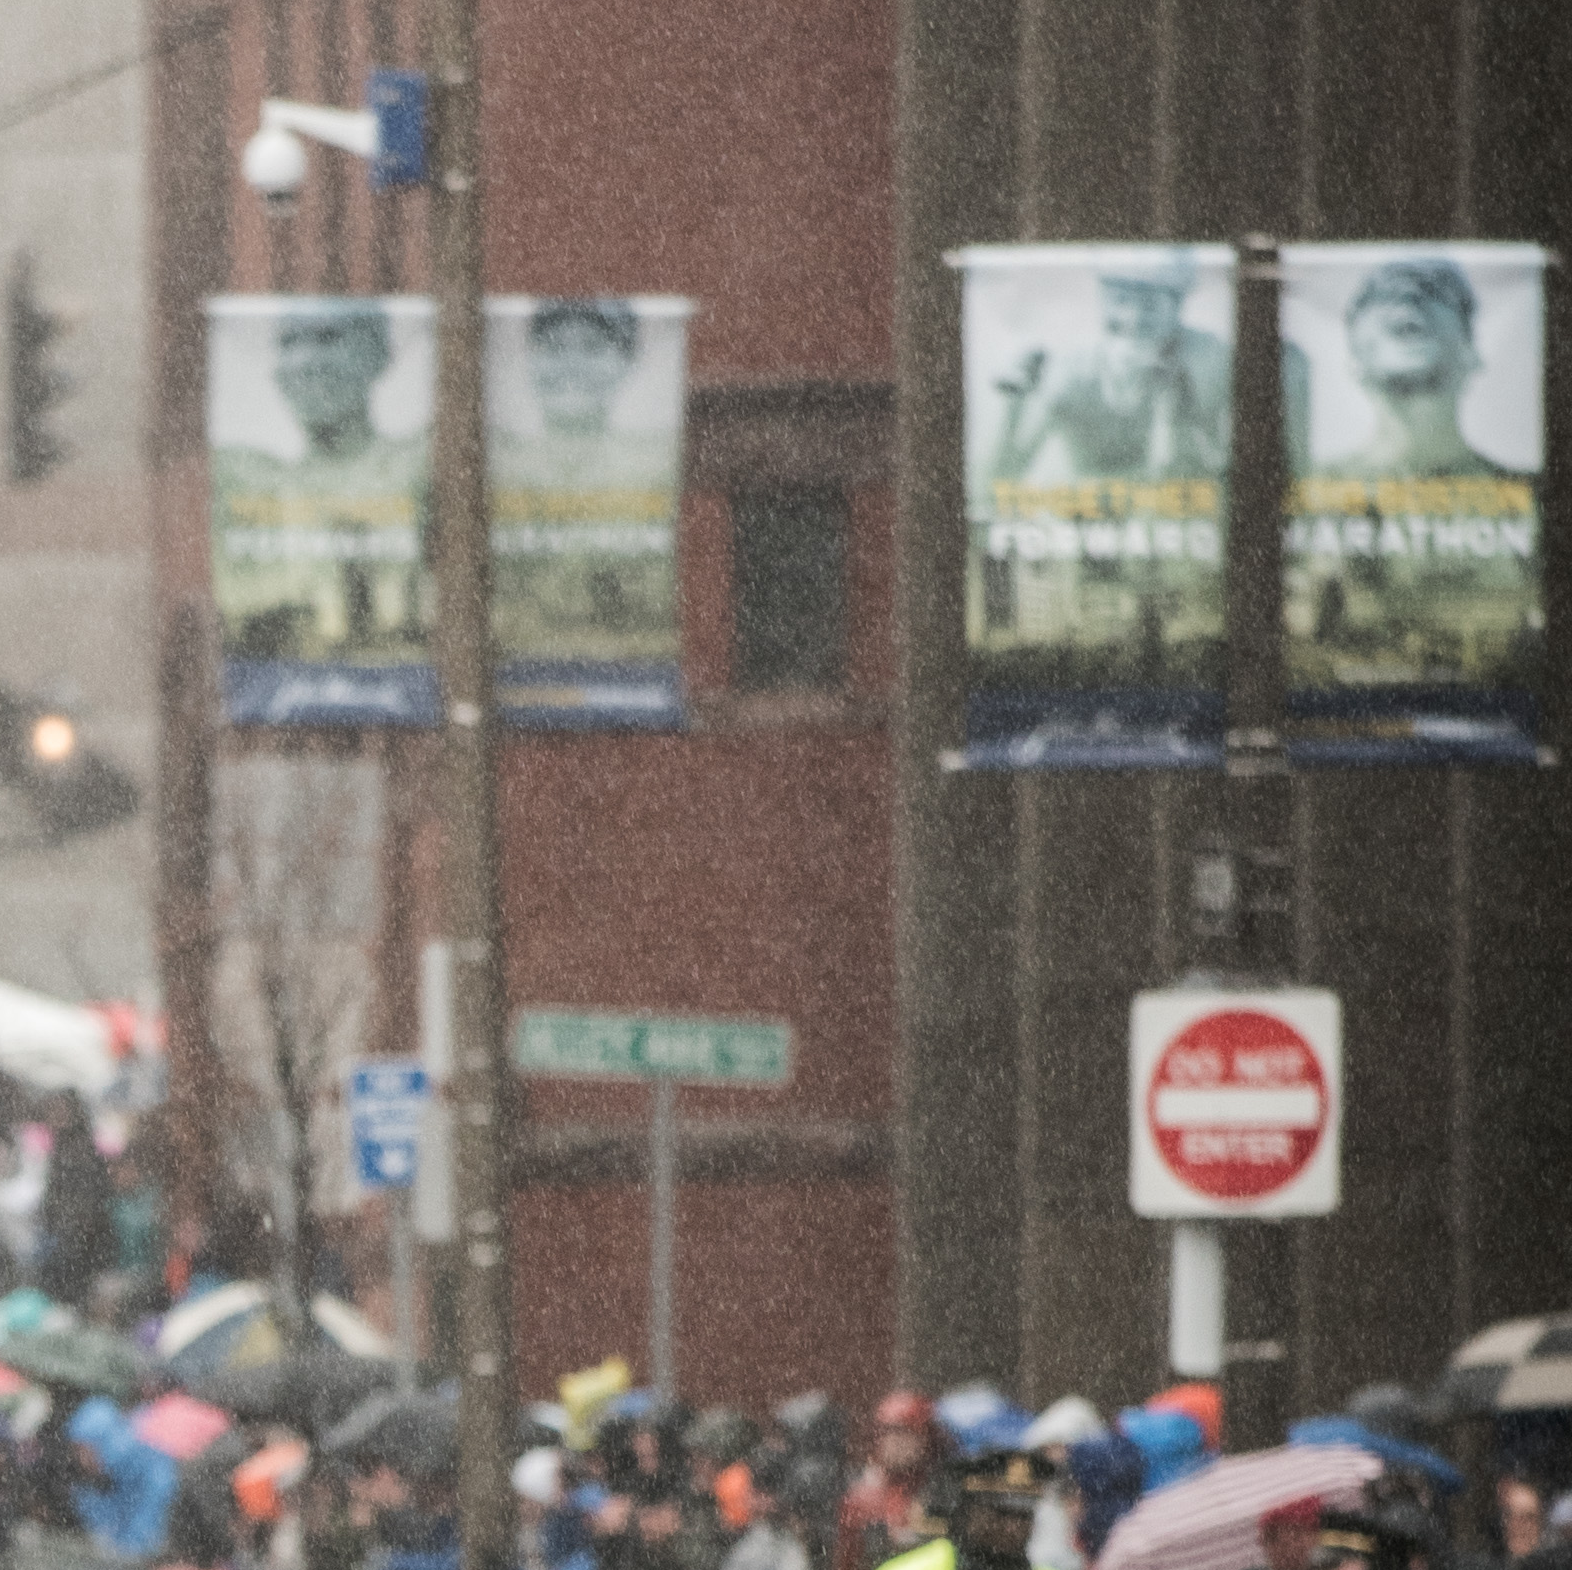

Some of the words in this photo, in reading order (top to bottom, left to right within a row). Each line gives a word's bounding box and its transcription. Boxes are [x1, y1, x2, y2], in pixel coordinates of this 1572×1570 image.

[985, 519, 1220, 560] FORWARD
[1278, 516, 1532, 560] MARATHON
[1232, 1045, 1305, 1081] NOT
[1180, 1132, 1293, 1166] ENTER
